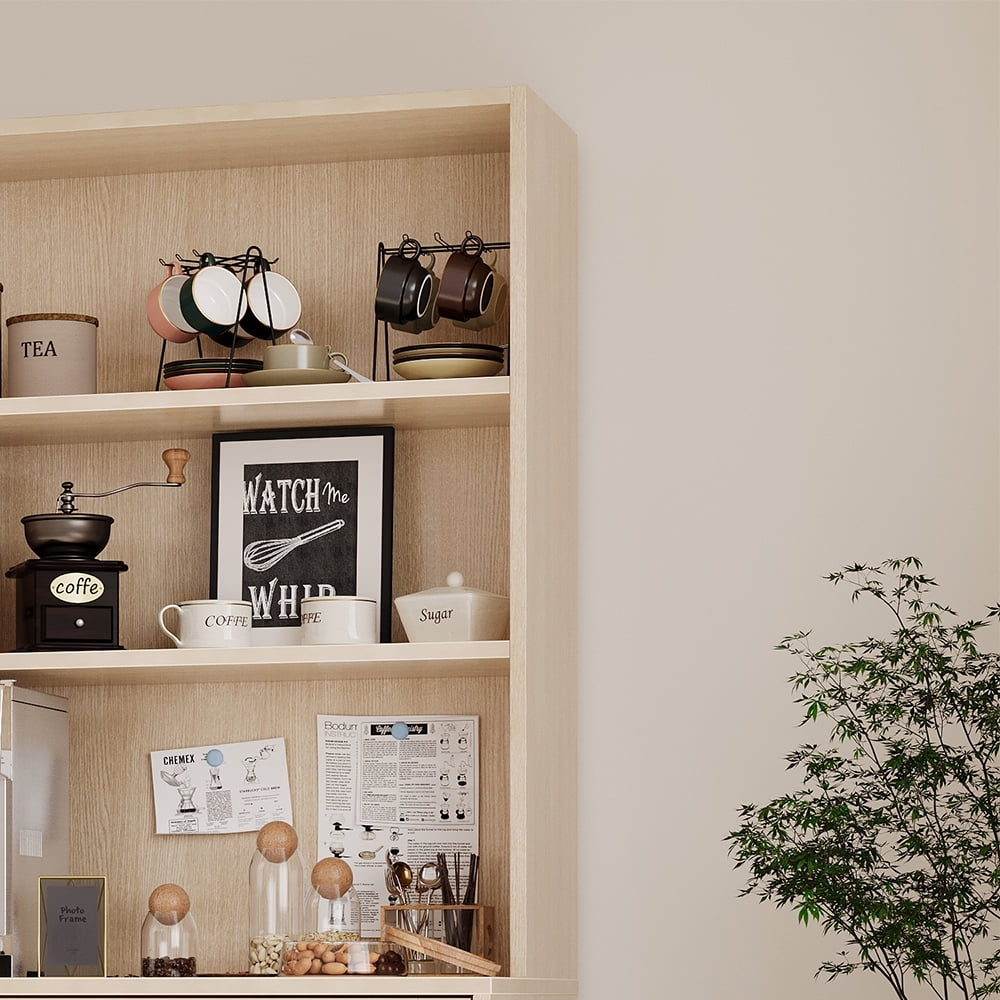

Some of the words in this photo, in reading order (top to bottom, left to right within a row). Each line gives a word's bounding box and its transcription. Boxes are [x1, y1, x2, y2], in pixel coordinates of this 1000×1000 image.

[21, 340, 57, 358] TEA
[242, 472, 320, 515] WATCH
[55, 577, 99, 595] coffe
[205, 614, 248, 628] COFFE
[420, 608, 453, 625] Sugar
[163, 754, 195, 766] CHEMEX
[60, 905, 85, 914] Photo
[59, 914, 87, 923] Frame
